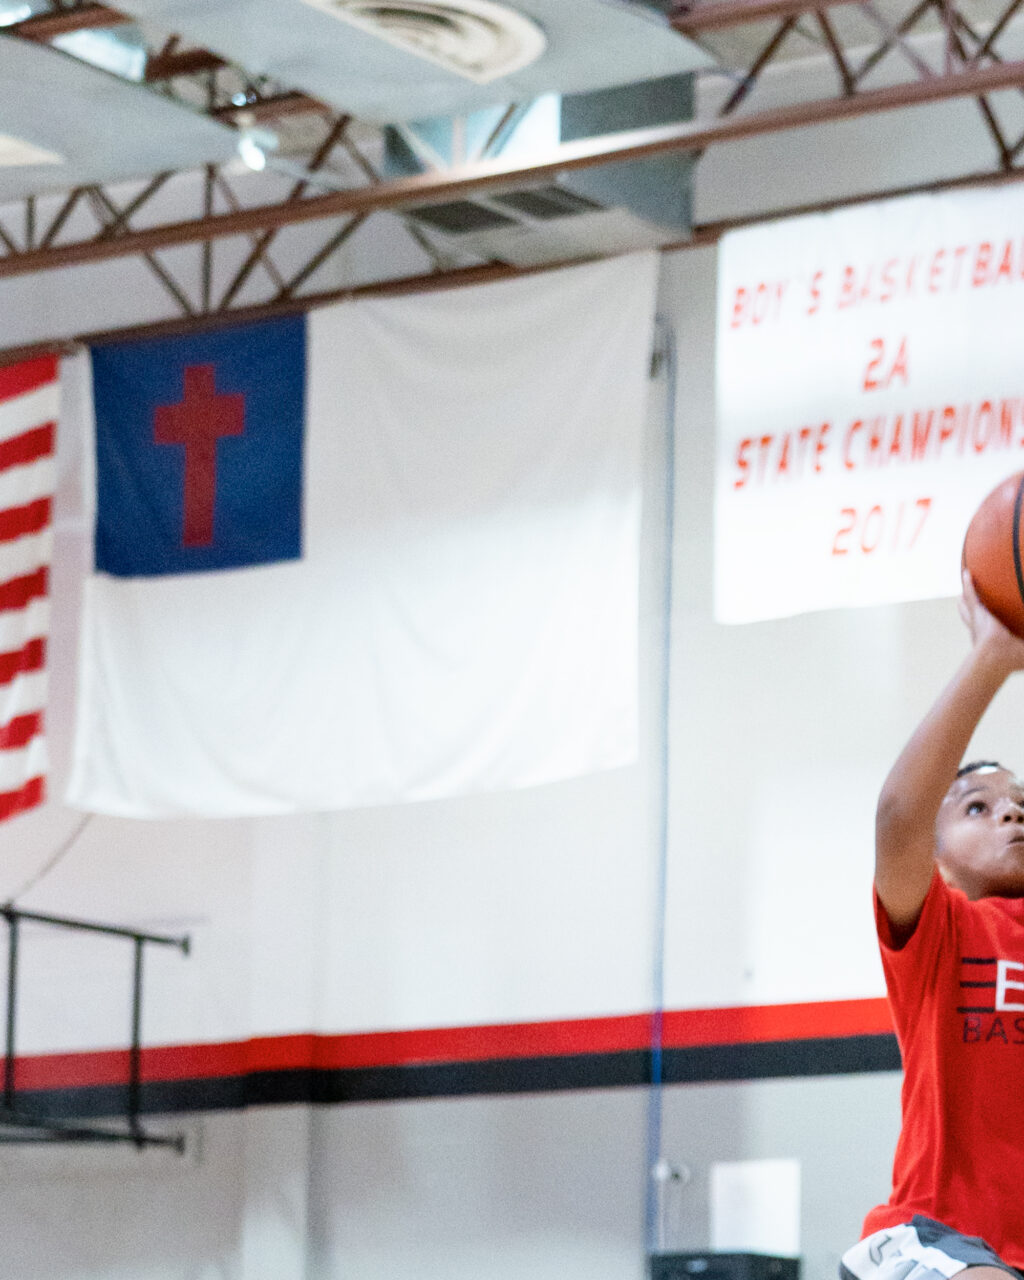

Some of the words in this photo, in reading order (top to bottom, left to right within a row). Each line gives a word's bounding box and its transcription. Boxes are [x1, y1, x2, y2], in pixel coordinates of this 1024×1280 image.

[862, 335, 909, 393] 2A
[733, 420, 832, 490] STATE
[832, 497, 932, 556] 2017
